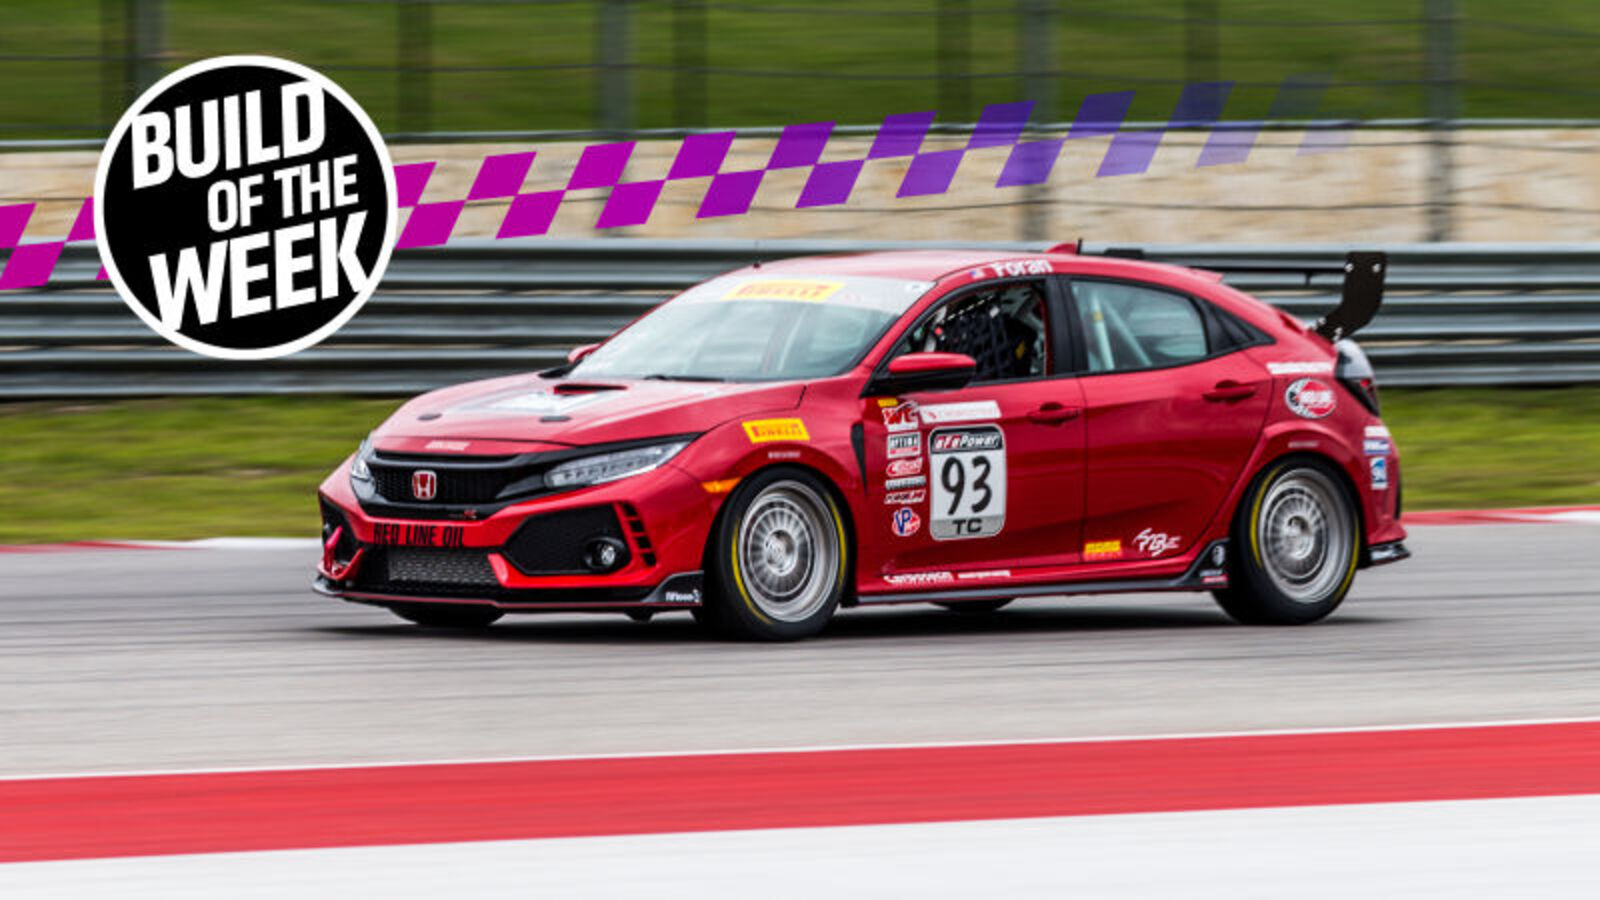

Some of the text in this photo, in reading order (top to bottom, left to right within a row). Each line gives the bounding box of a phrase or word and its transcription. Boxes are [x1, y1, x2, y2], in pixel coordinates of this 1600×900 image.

[992, 259, 1054, 277] Foran
[941, 455, 993, 516] 93
[373, 522, 465, 546] RED LINE OIL
[953, 517, 983, 535] TC
